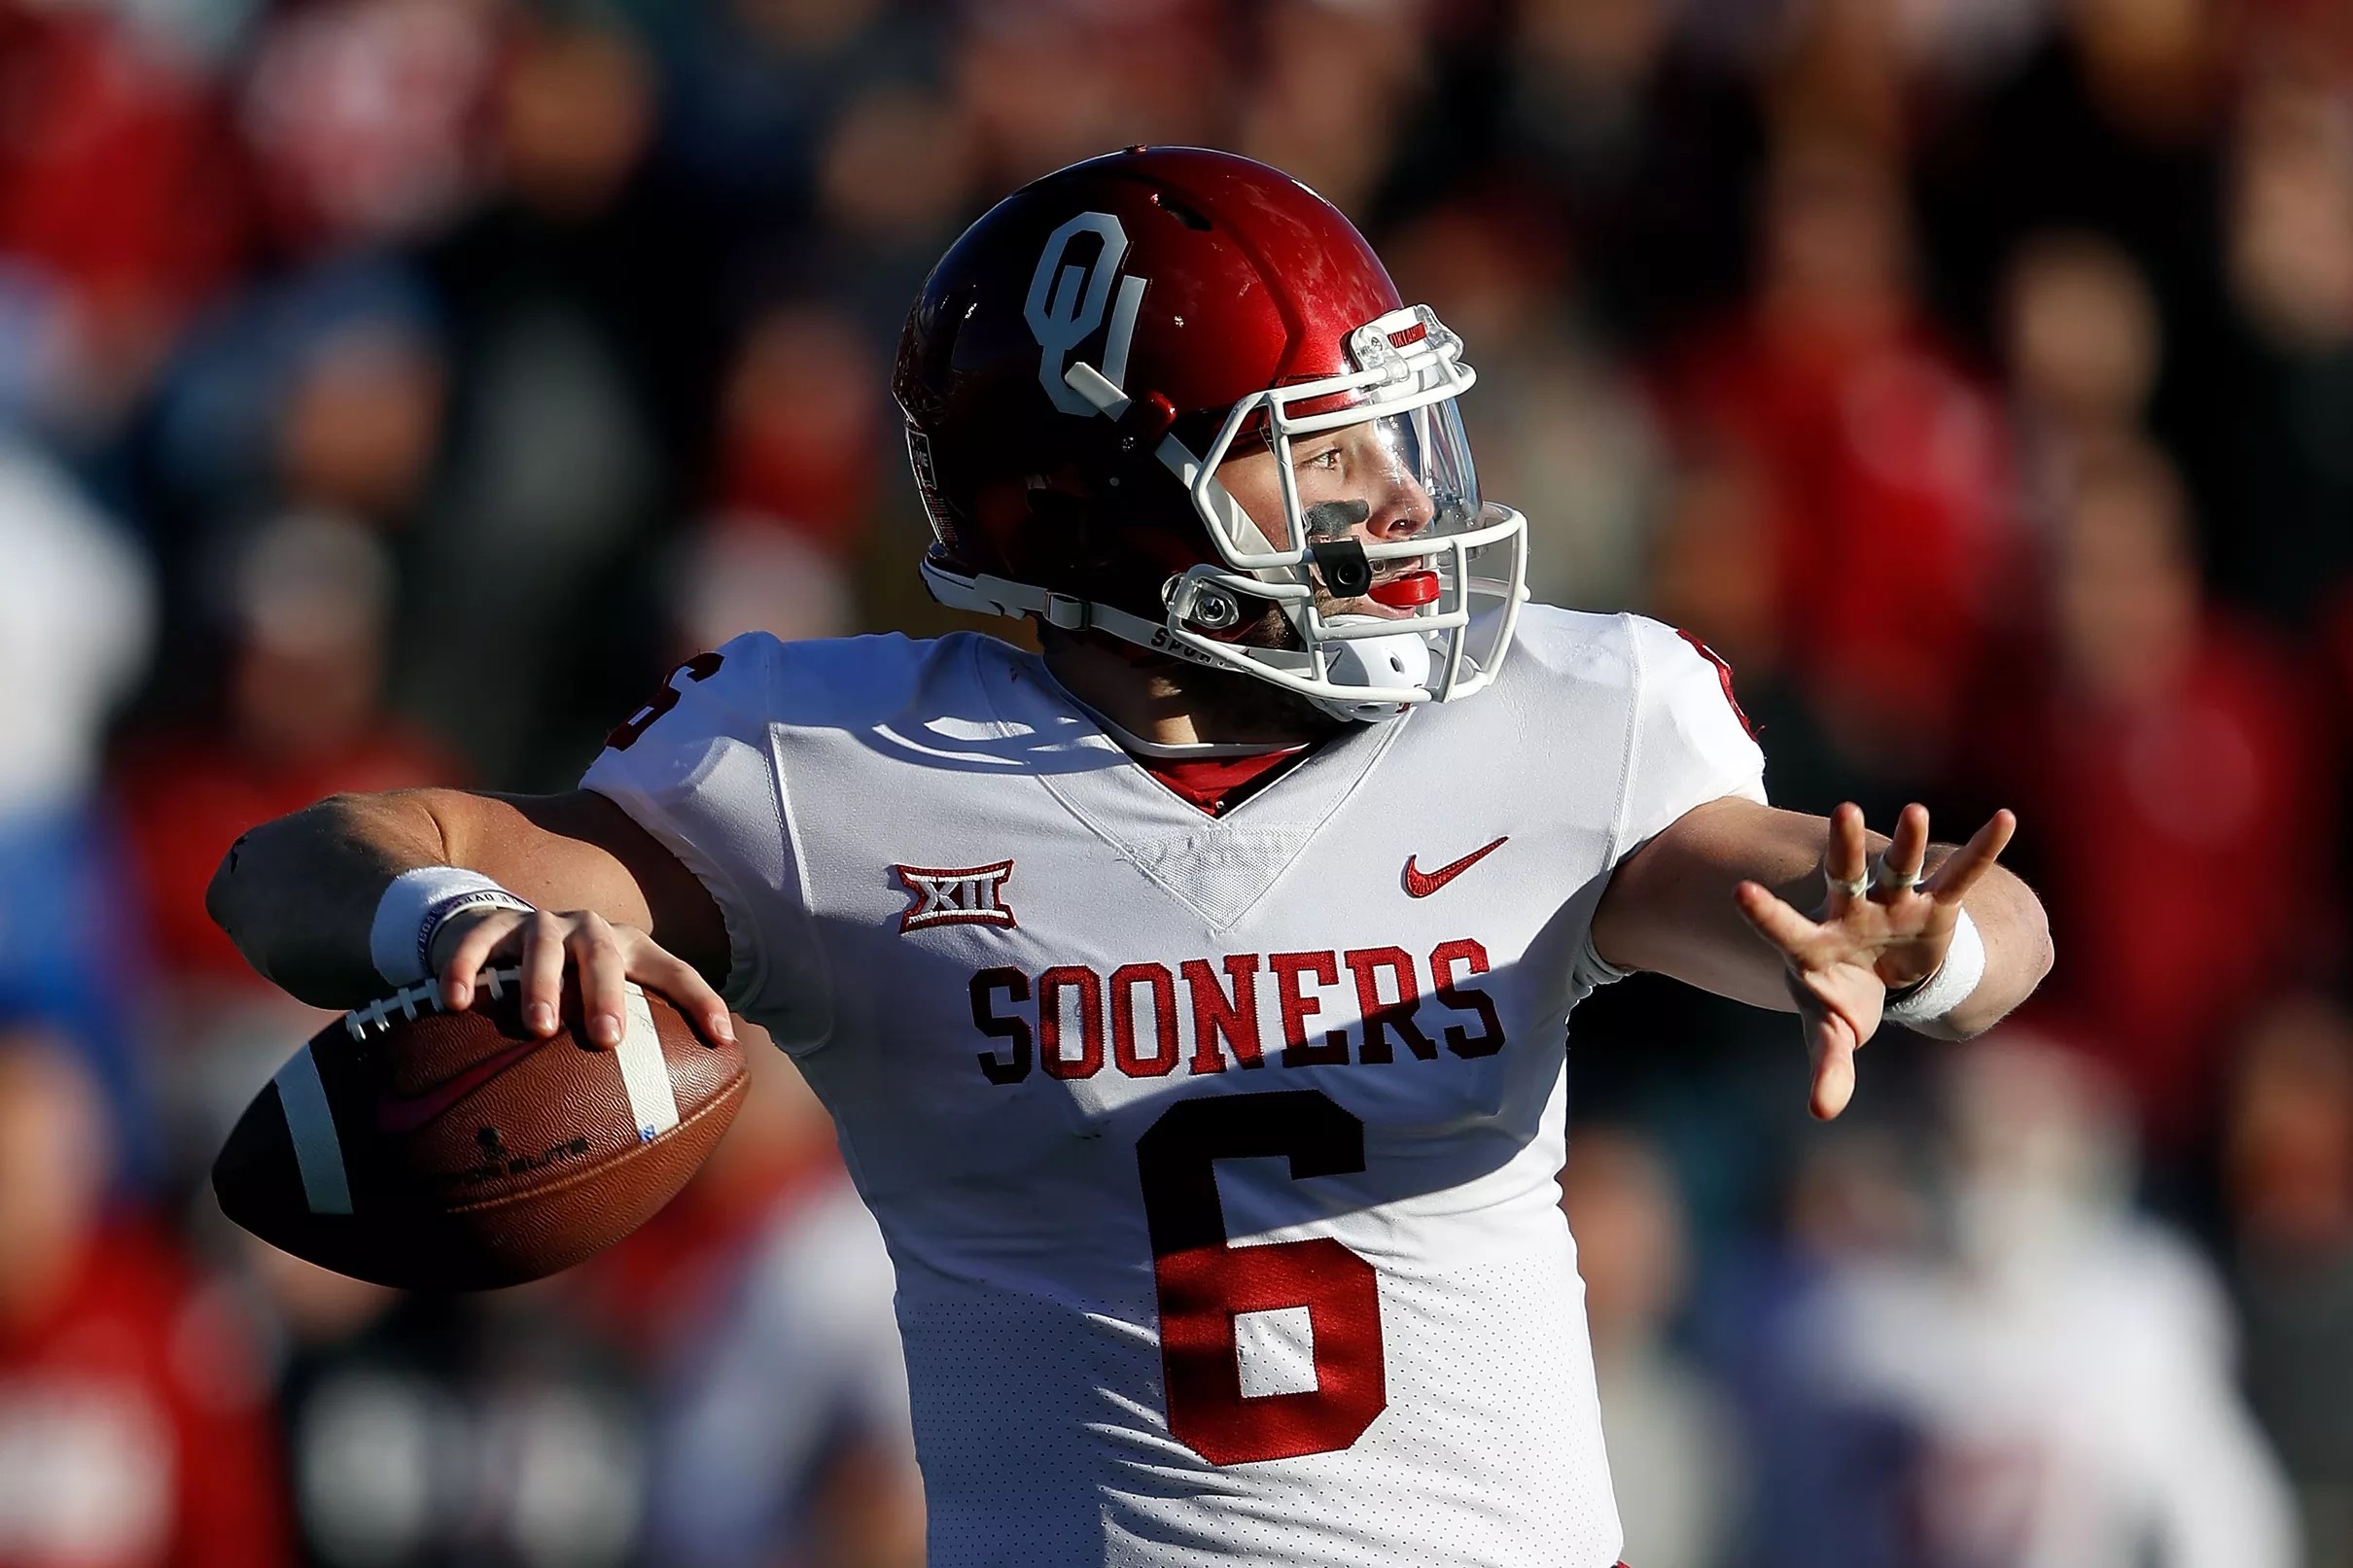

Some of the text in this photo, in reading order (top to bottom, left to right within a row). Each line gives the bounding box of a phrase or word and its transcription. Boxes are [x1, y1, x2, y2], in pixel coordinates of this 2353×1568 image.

[1150, 627, 1224, 667] SPO
[907, 869, 1007, 922] XII
[968, 938, 1506, 1086] SOONERS
[1136, 1089, 1387, 1466] 6
